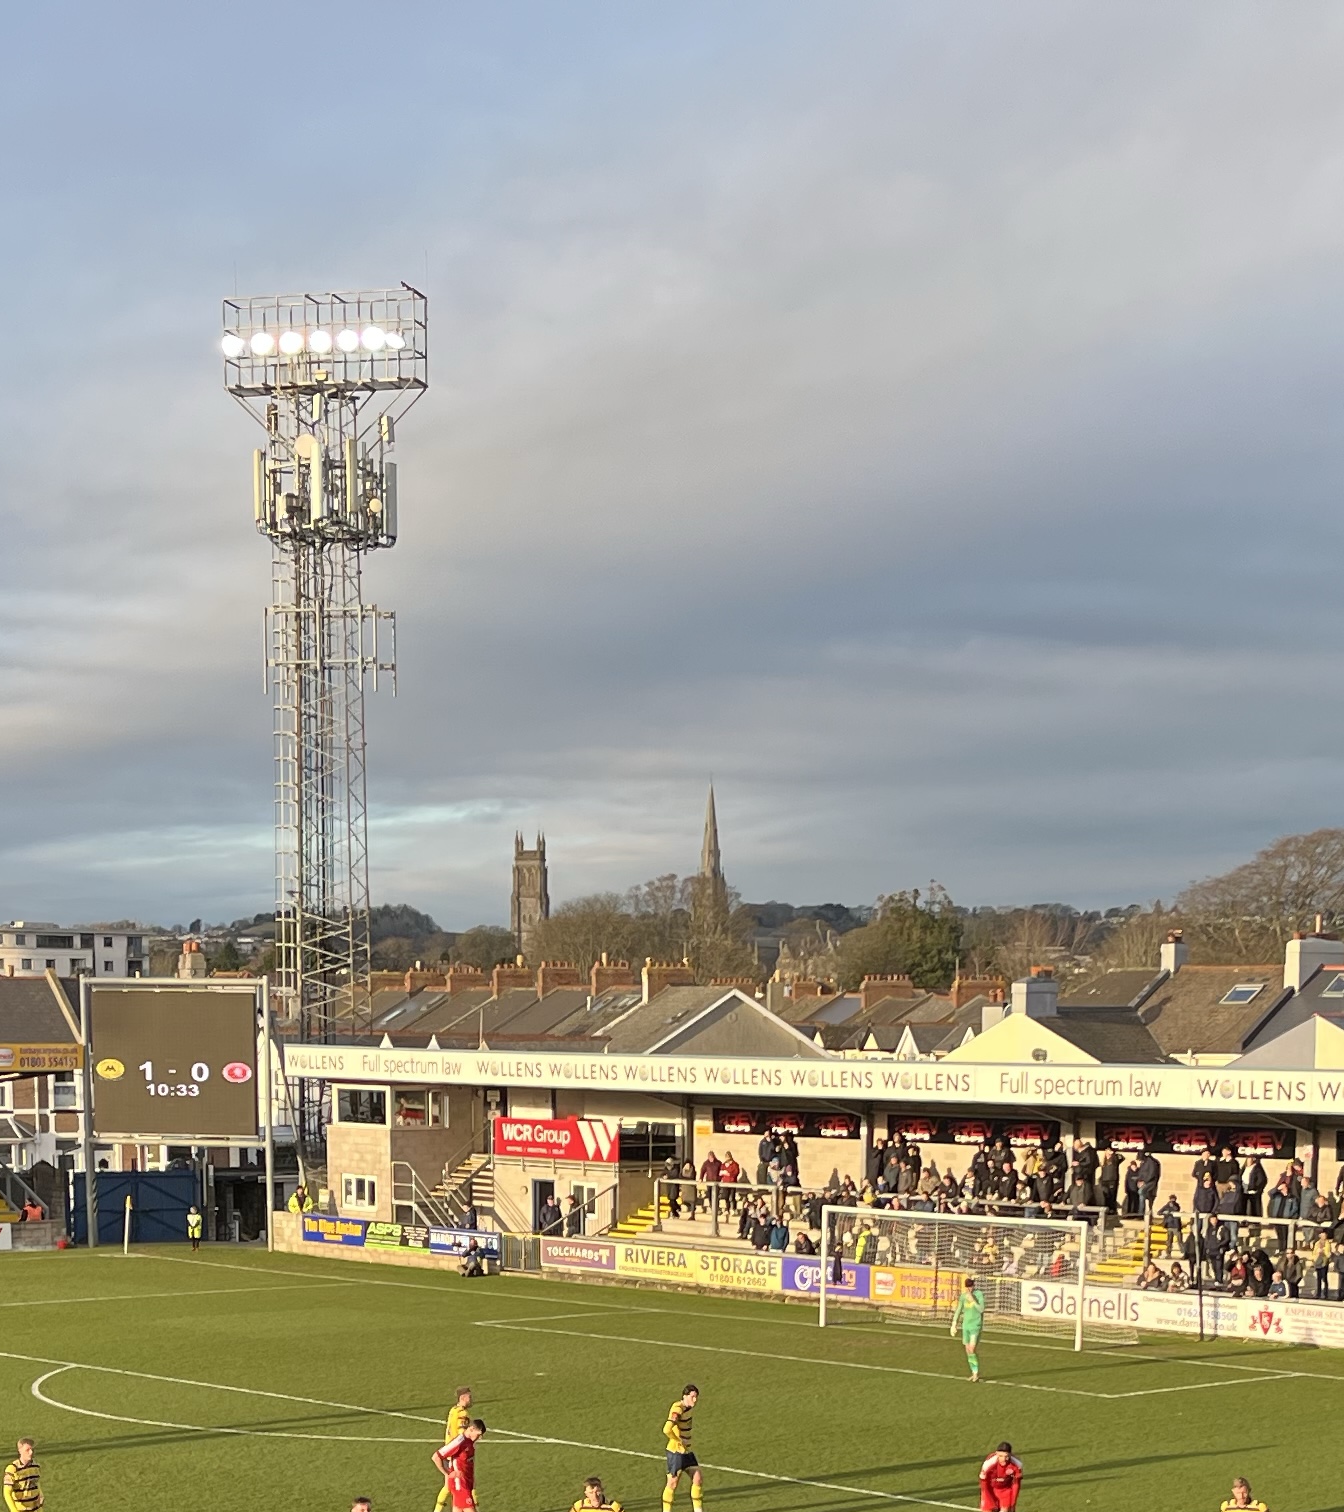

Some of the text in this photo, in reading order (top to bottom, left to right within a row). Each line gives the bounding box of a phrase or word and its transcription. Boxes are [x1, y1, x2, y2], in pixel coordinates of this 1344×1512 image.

[20, 1056, 79, 1067] 01803 554151
[139, 1062, 210, 1082] 1 0
[362, 1054, 381, 1072] Full
[383, 1057, 439, 1080] spectrum
[441, 1057, 462, 1076] law
[999, 1071, 1029, 1095] Full
[1034, 1073, 1124, 1100] spectrum
[1128, 1073, 1162, 1098] law
[1197, 1078, 1307, 1102] WOLLENS
[146, 1083, 200, 1097] 10:33
[501, 1123, 571, 1147] WCR Group
[546, 1246, 599, 1262] TOLCHARDS
[624, 1248, 778, 1277] RIVIERA STORAGE
[709, 1273, 734, 1284] 01803
[1050, 1290, 1140, 1322] danells
[1156, 1317, 1238, 1331] www.darnlls.co.uk
